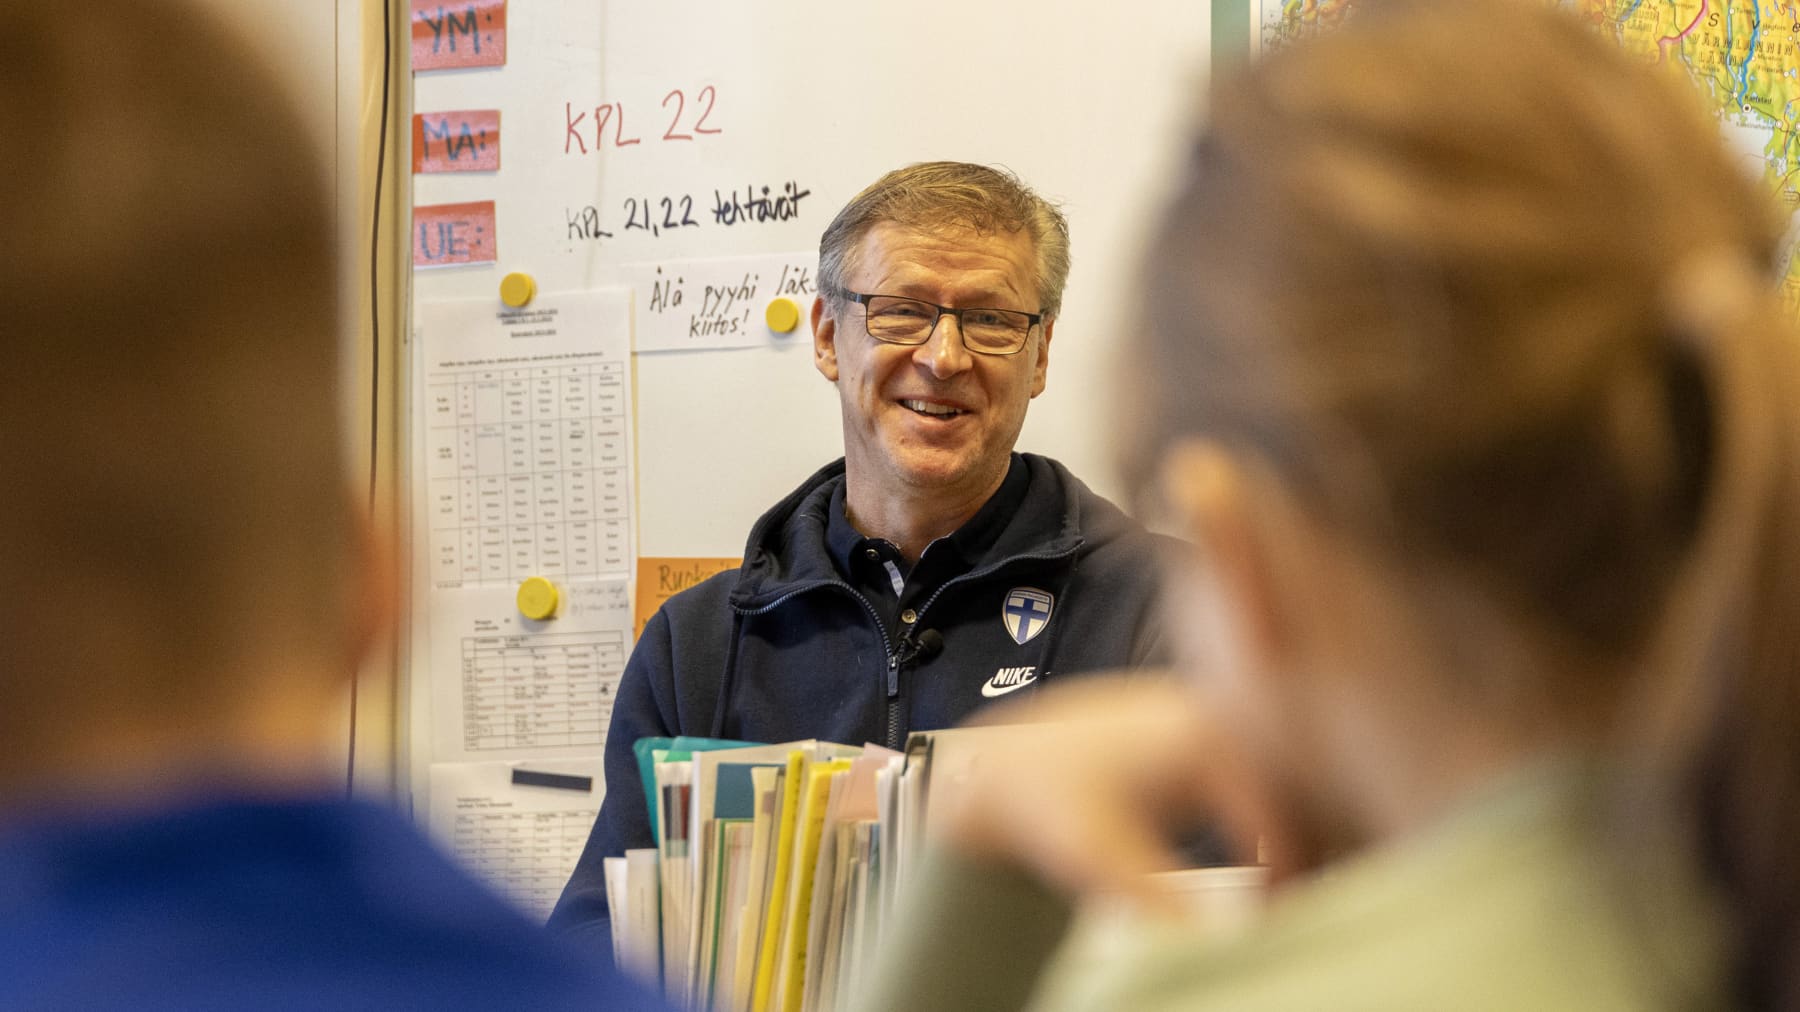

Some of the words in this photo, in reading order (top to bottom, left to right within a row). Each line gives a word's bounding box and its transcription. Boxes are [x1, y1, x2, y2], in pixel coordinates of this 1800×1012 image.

[422, 119, 487, 161] MA:
[565, 101, 641, 154] KPL
[662, 85, 722, 140] 22
[420, 222, 483, 260] UE:
[700, 273, 759, 318] pyyhi
[993, 666, 1036, 685] NIKE
